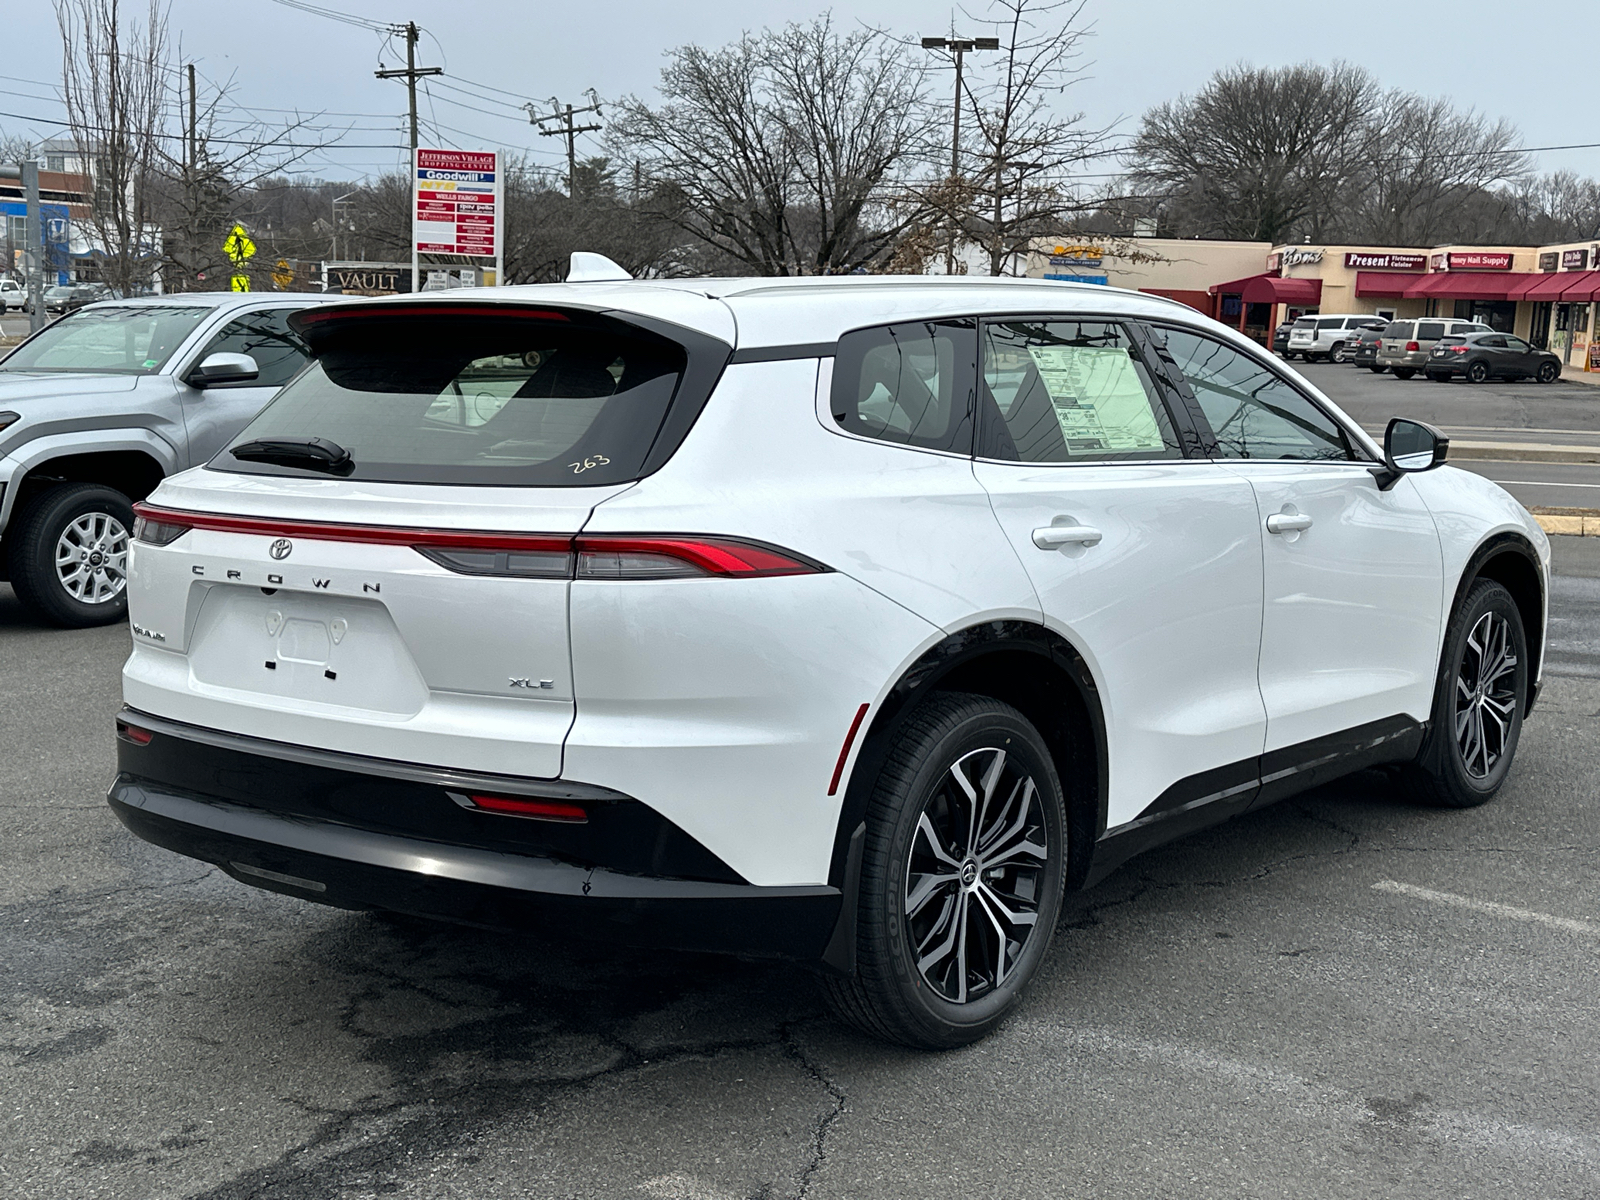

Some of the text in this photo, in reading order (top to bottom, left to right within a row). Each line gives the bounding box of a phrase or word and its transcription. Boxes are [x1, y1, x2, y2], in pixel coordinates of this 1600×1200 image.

[420, 152, 494, 163] JEFFERSON VILLAGE
[426, 170, 478, 182] Goodwill
[421, 181, 456, 191] NTB
[435, 192, 457, 200] WELLS
[1349, 254, 1390, 267] Present
[1391, 255, 1424, 263] Vietnamese
[1467, 256, 1481, 264] Nail
[1482, 256, 1509, 266] Supply
[338, 272, 398, 290] VAULT
[567, 454, 611, 474] 263
[191, 565, 382, 594] CROWN
[508, 676, 554, 690] XLE
